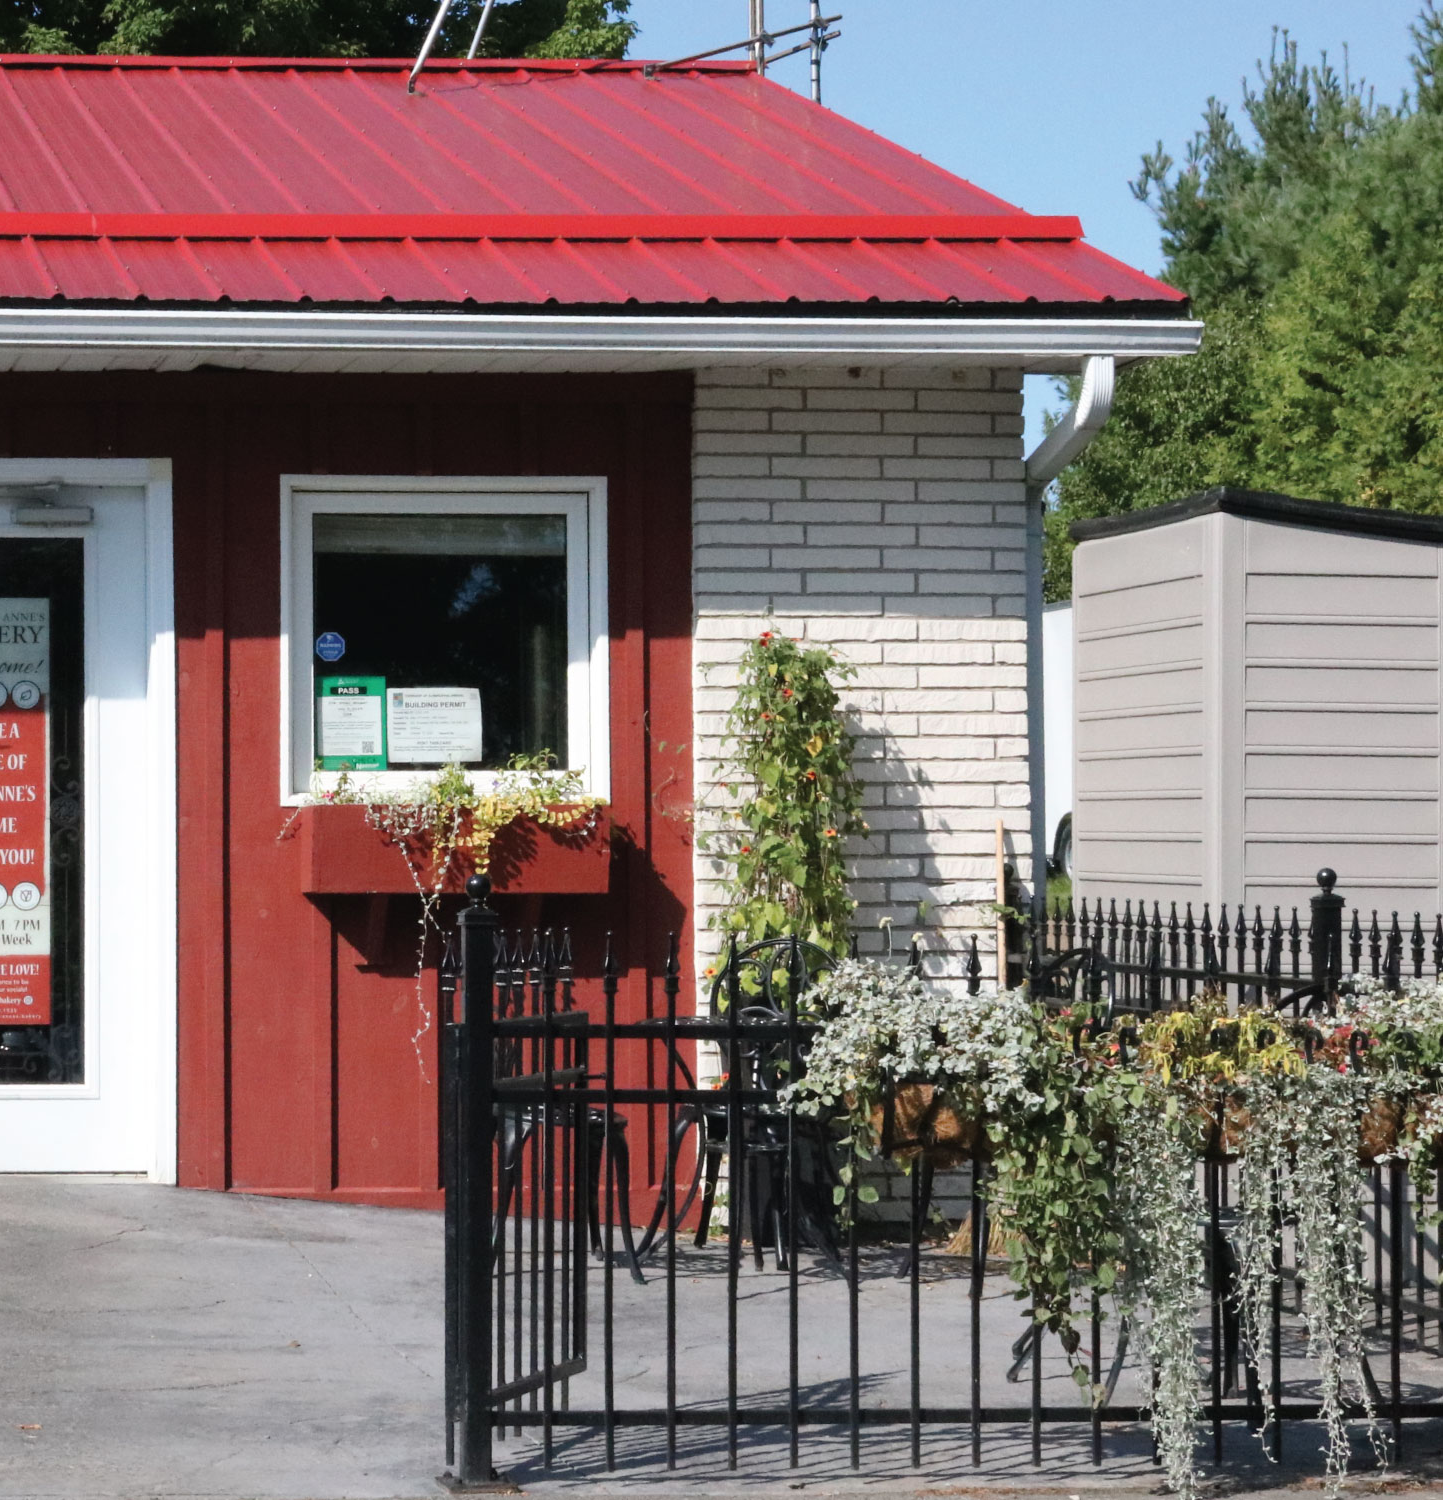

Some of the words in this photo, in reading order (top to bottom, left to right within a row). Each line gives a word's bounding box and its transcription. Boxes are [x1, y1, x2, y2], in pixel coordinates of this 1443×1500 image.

[9, 722, 20, 739] A
[7, 754, 28, 770] OF
[14, 919, 21, 931] 7
[22, 919, 41, 931] PM
[1, 933, 33, 945] Week
[9, 964, 40, 976] LOVE!
